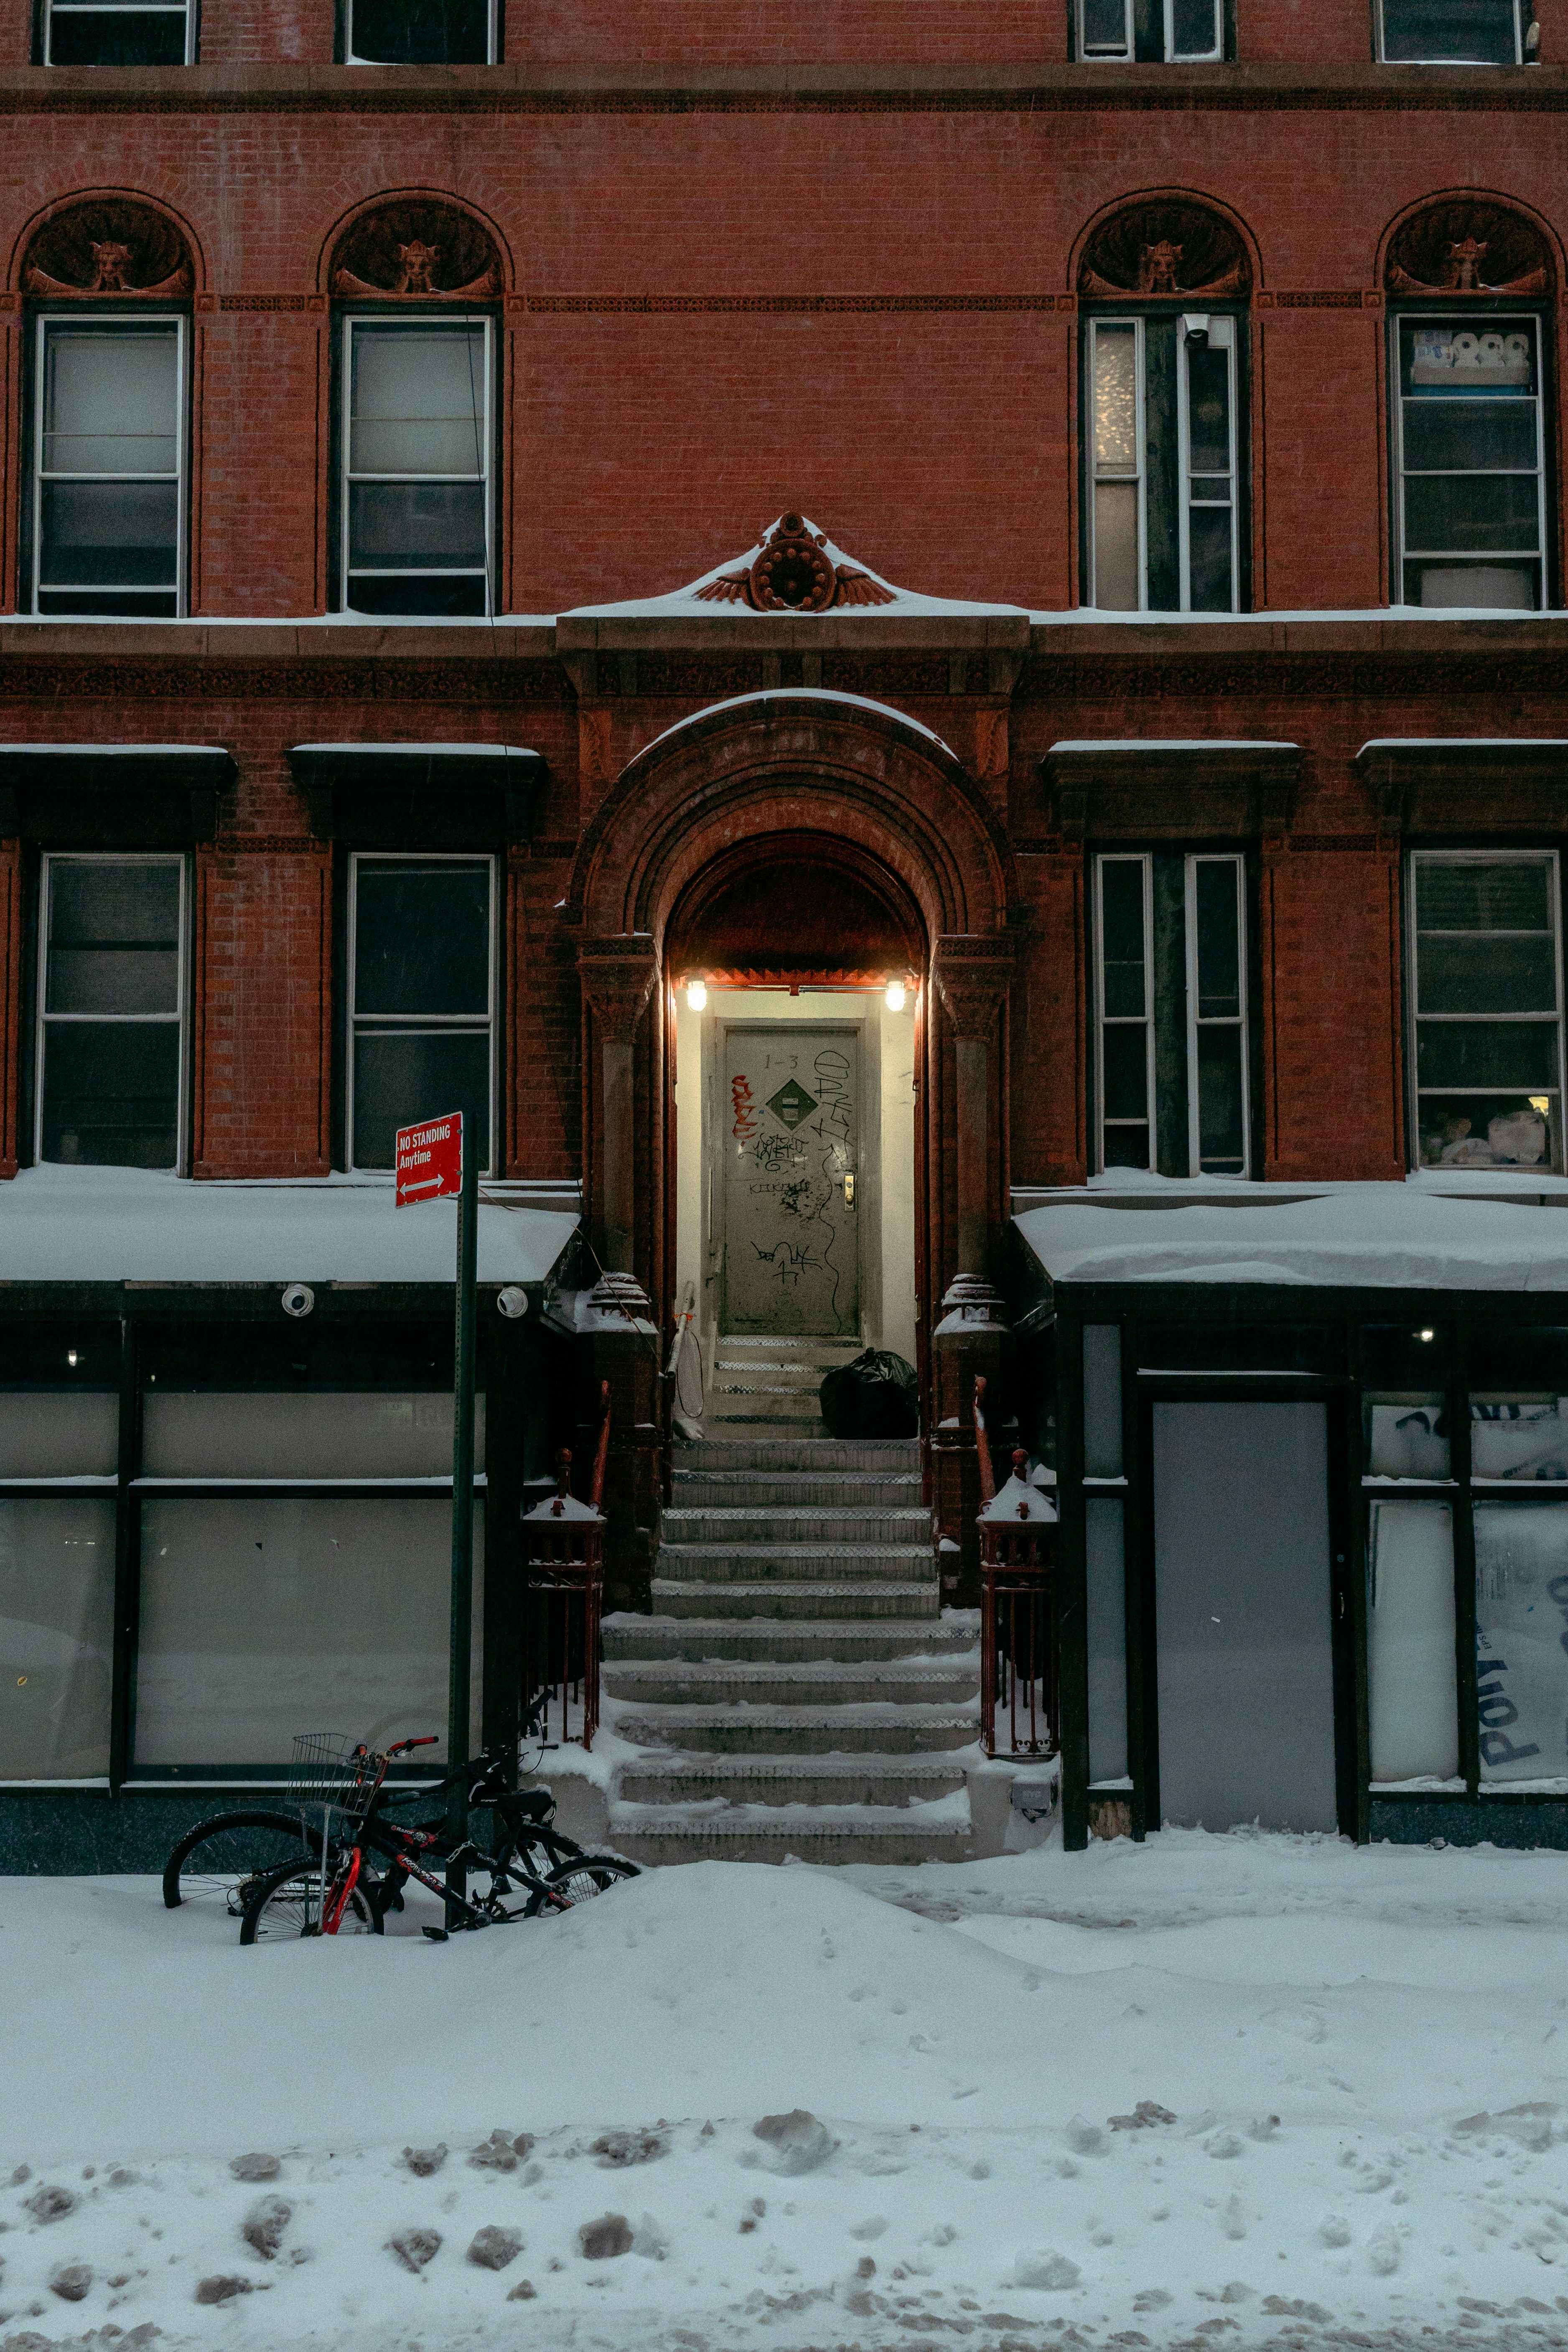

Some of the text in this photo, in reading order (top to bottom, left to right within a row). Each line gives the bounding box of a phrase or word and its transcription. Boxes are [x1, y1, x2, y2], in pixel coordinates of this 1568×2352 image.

[400, 1124, 451, 1151] NO STANDING
[400, 1150, 431, 1170] Anytime
[397, 1827, 415, 1835] Razor
[402, 1857, 437, 1886] AGGRESSOR
